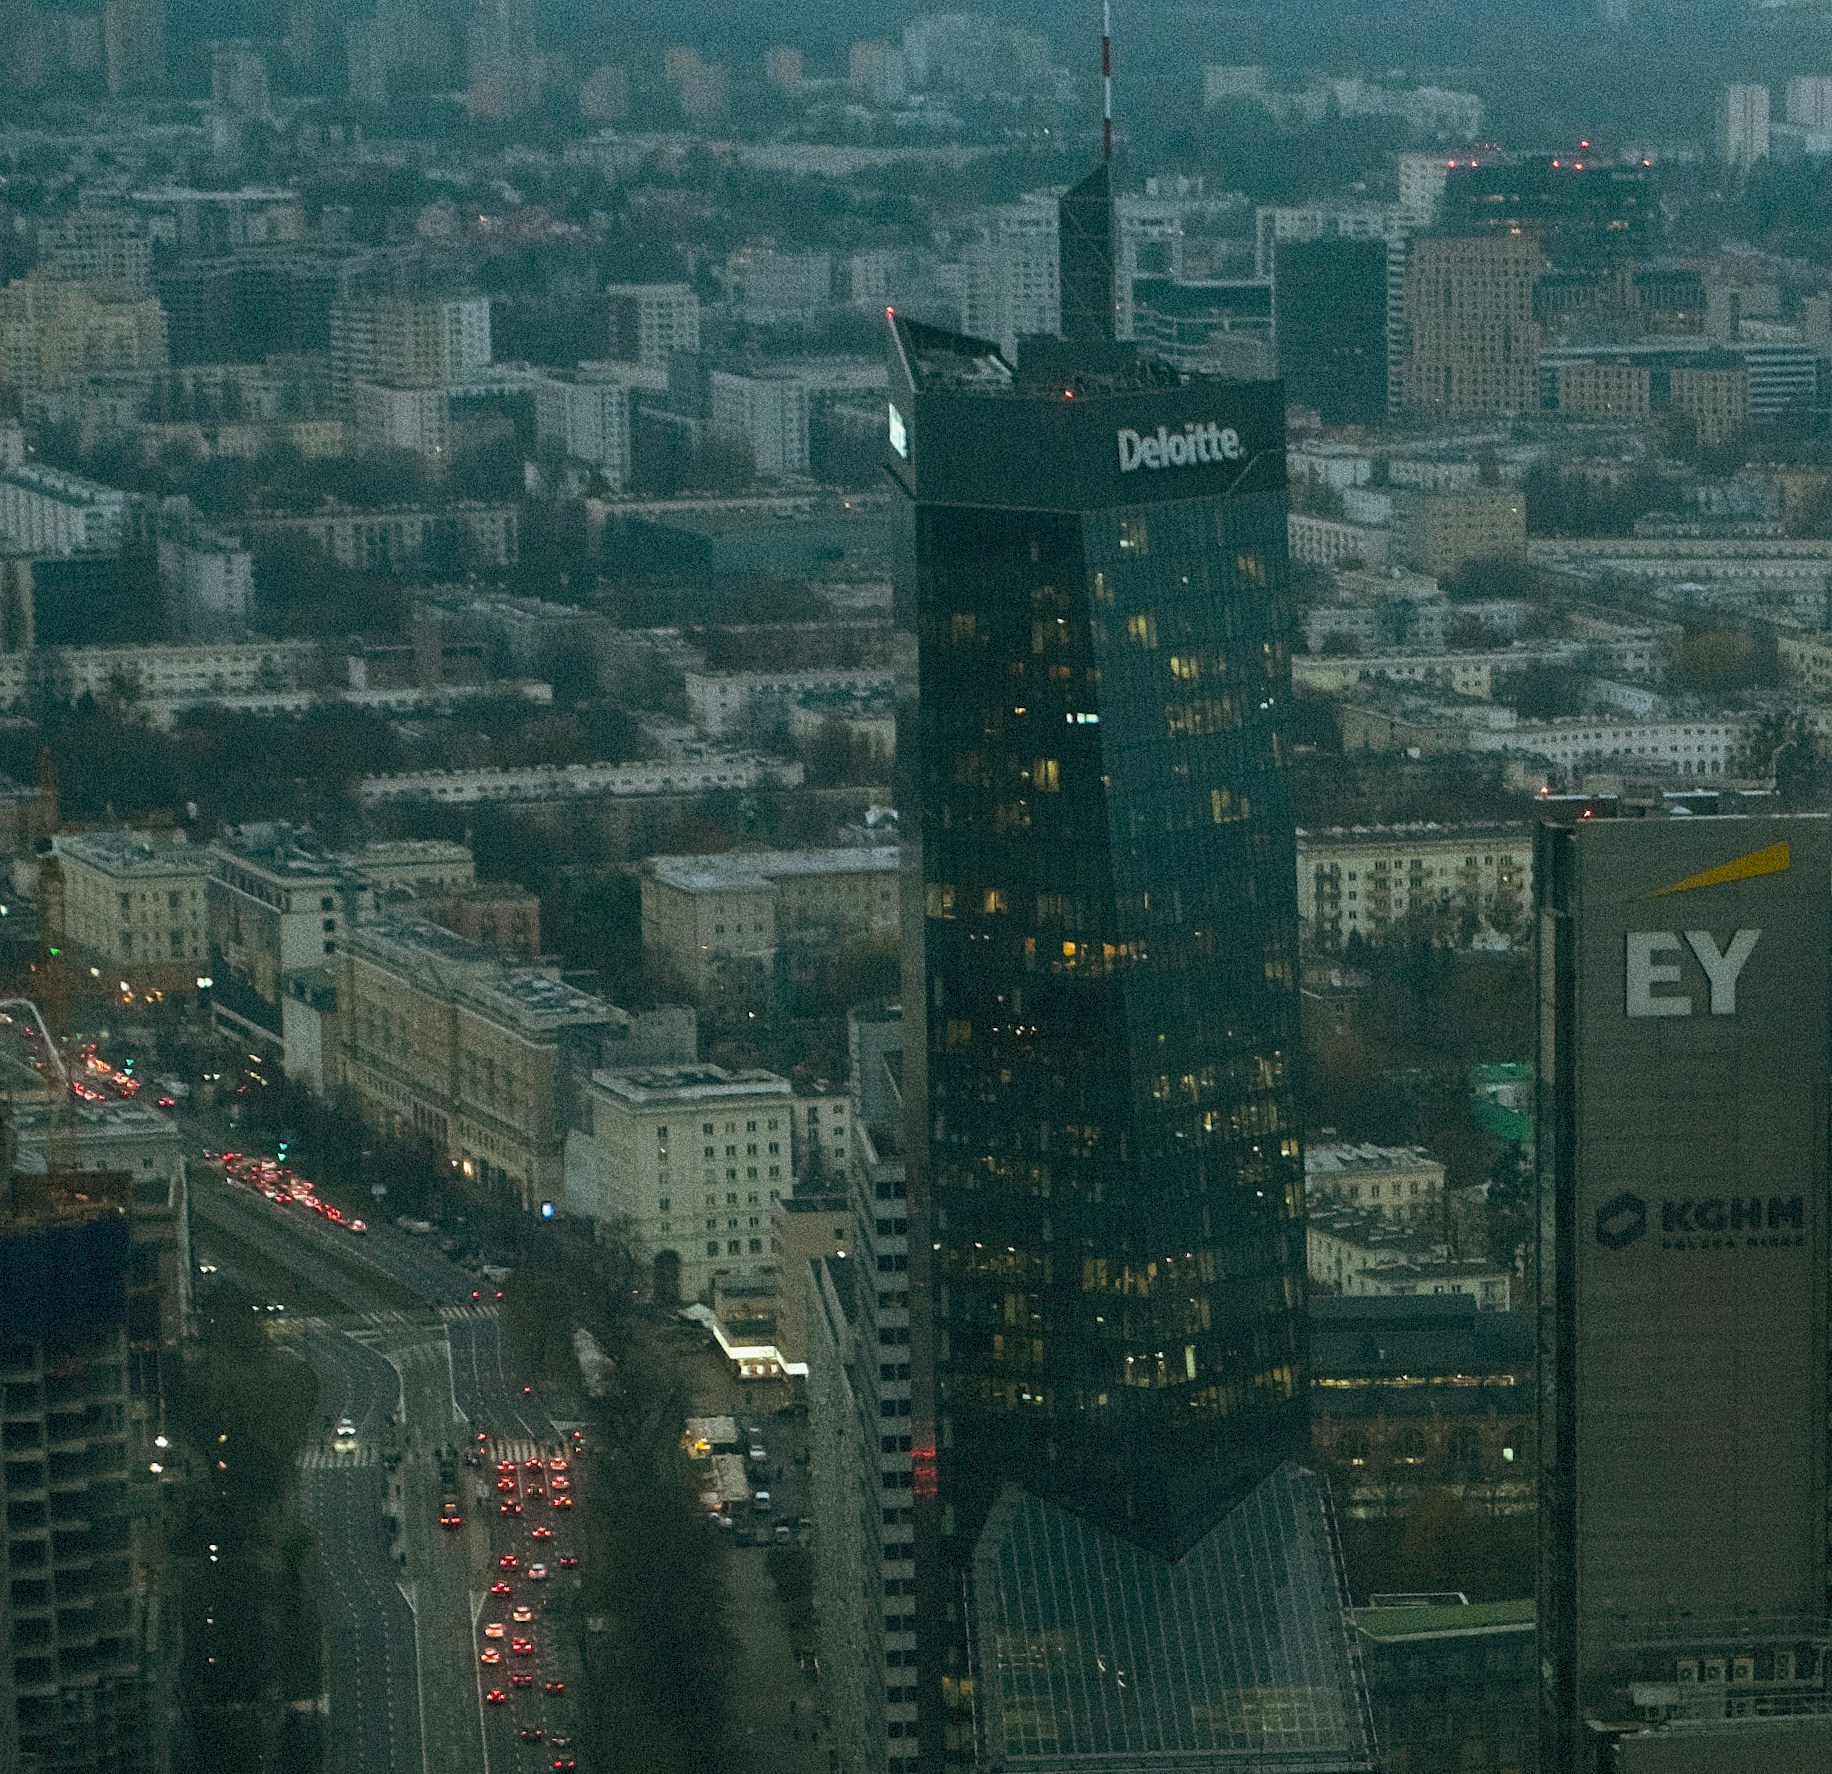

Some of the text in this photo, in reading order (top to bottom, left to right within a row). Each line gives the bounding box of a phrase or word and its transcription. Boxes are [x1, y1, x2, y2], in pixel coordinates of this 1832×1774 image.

[1117, 421, 1248, 473] Deloitte.
[1626, 929, 1762, 1018] EY
[1661, 1197, 1804, 1232] KGHM
